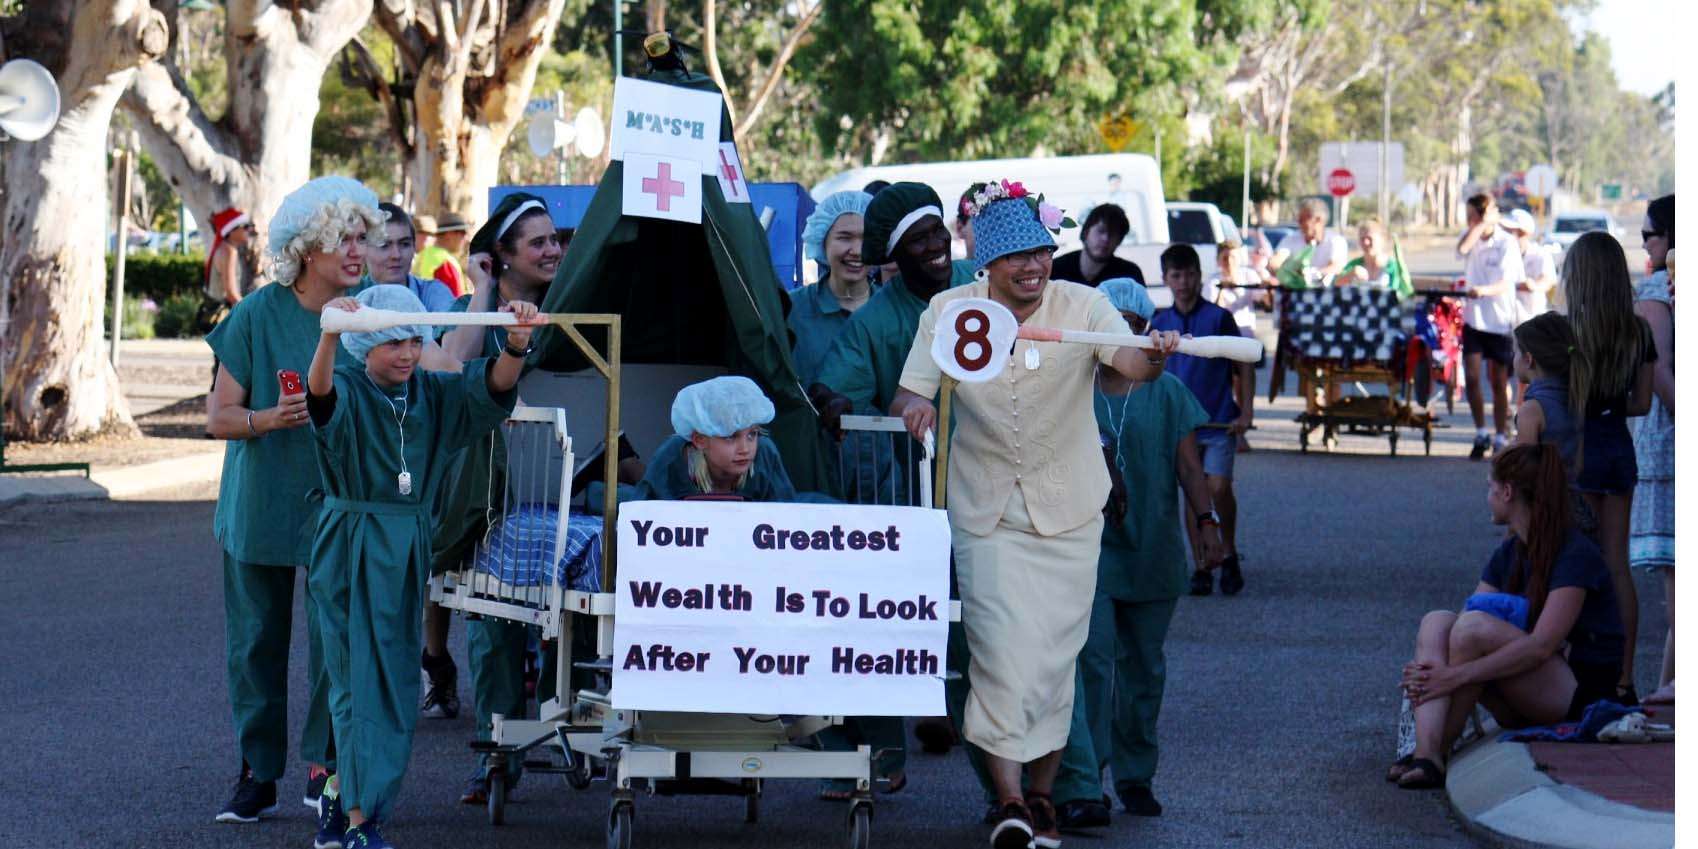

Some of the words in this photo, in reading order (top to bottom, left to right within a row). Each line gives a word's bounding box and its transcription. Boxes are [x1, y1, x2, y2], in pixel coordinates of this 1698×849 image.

[954, 309, 992, 371] 8
[631, 520, 709, 547] Your
[752, 524, 901, 551] Greatest
[629, 581, 752, 611] Wealth
[775, 587, 804, 613] Is
[812, 591, 850, 617] To
[859, 593, 938, 620] Look
[623, 644, 710, 672] After
[733, 648, 810, 675] Your
[831, 647, 938, 675] Health
